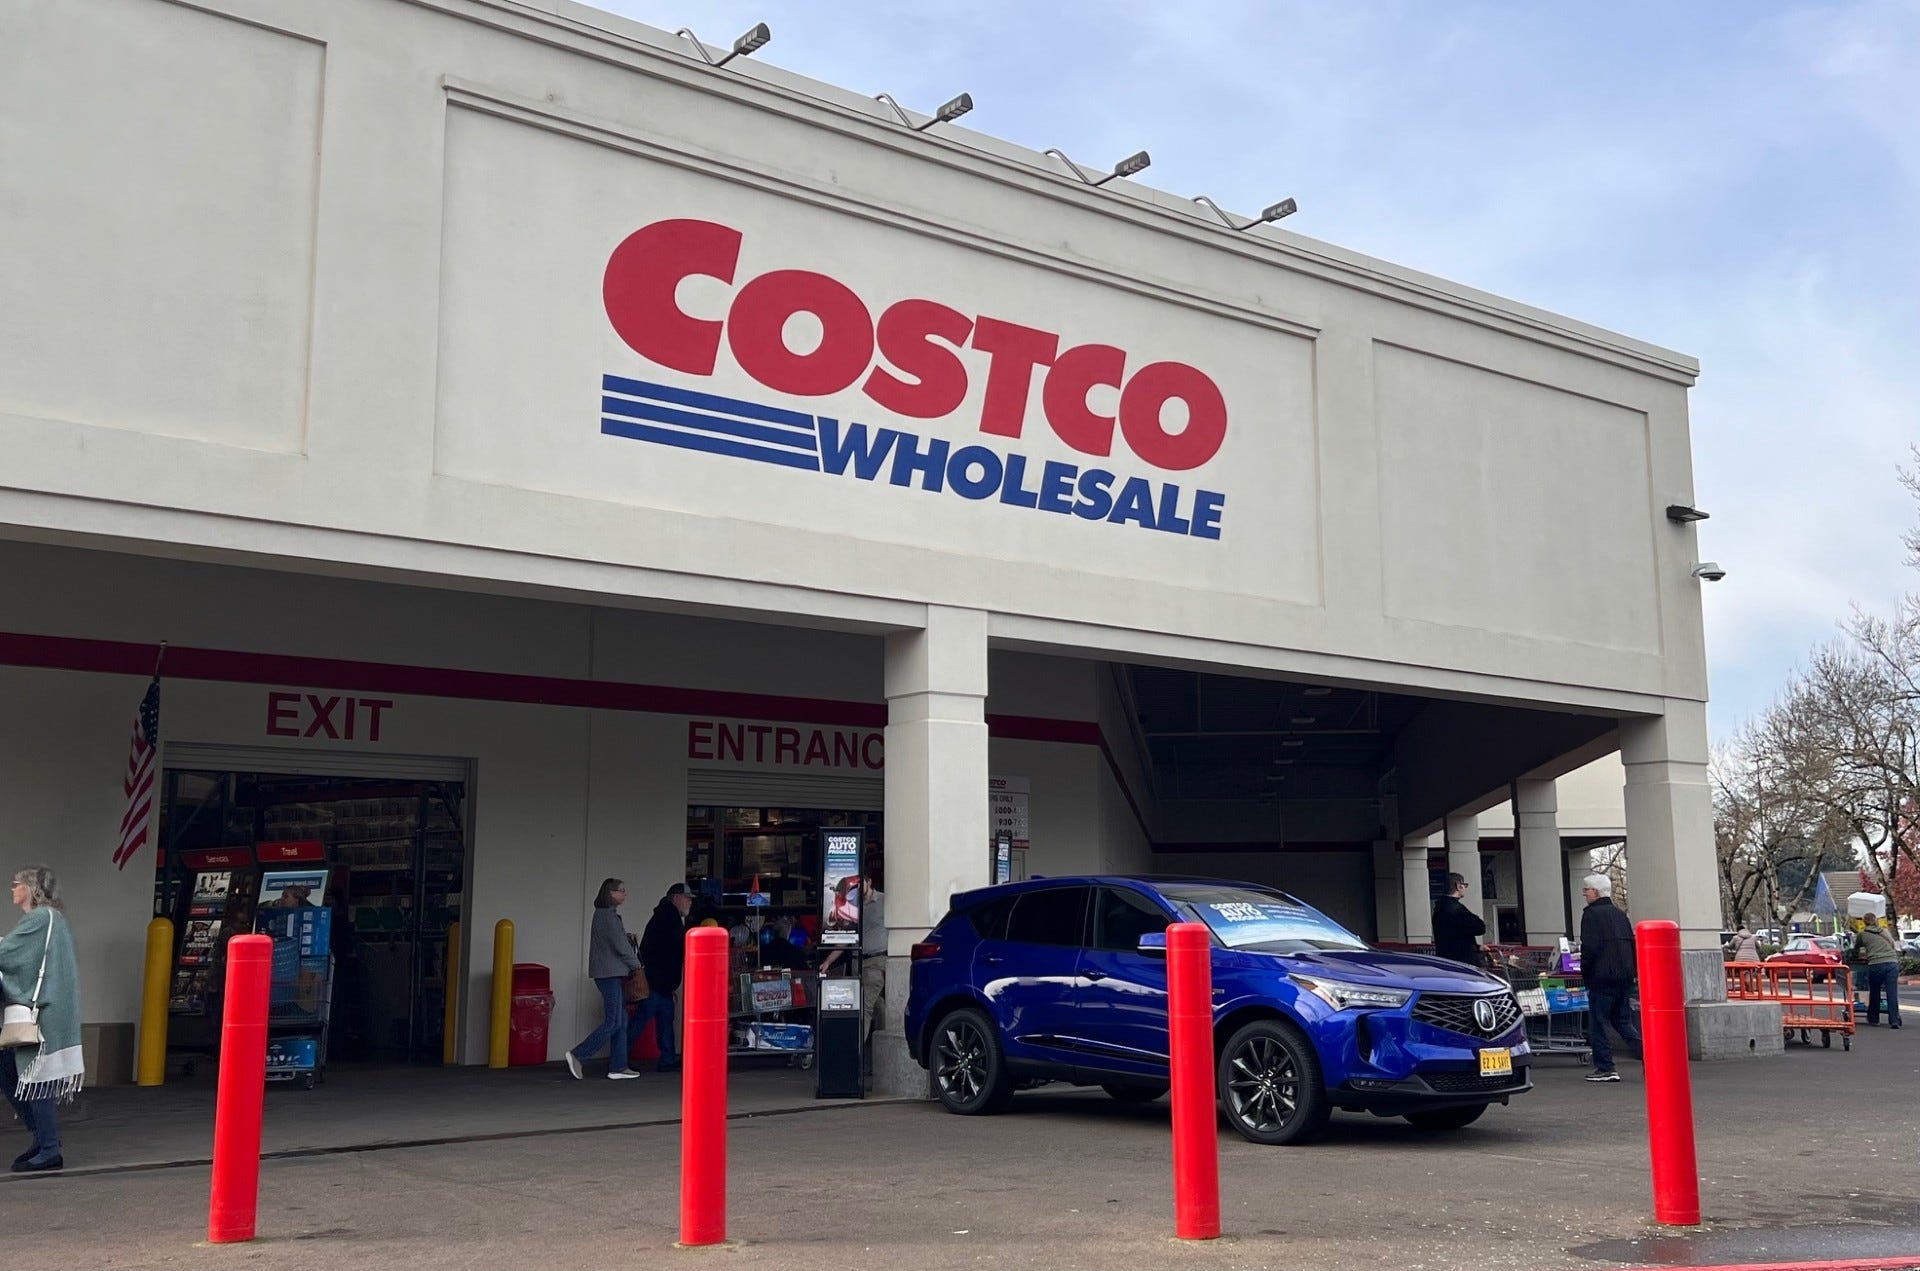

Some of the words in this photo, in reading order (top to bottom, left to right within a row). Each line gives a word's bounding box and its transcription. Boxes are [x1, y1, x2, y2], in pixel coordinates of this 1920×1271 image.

[603, 218, 1227, 471] COSTCO
[817, 415, 1226, 540] WHOLESALE
[266, 692, 393, 741] EXIT
[688, 721, 884, 770] ENTRANC
[828, 842, 857, 850] AUTO
[1209, 902, 1252, 910] COSTCO
[1220, 905, 1262, 917] AUTO
[1482, 1057, 1490, 1069] EZ
[1492, 1056, 1496, 1069] 2
